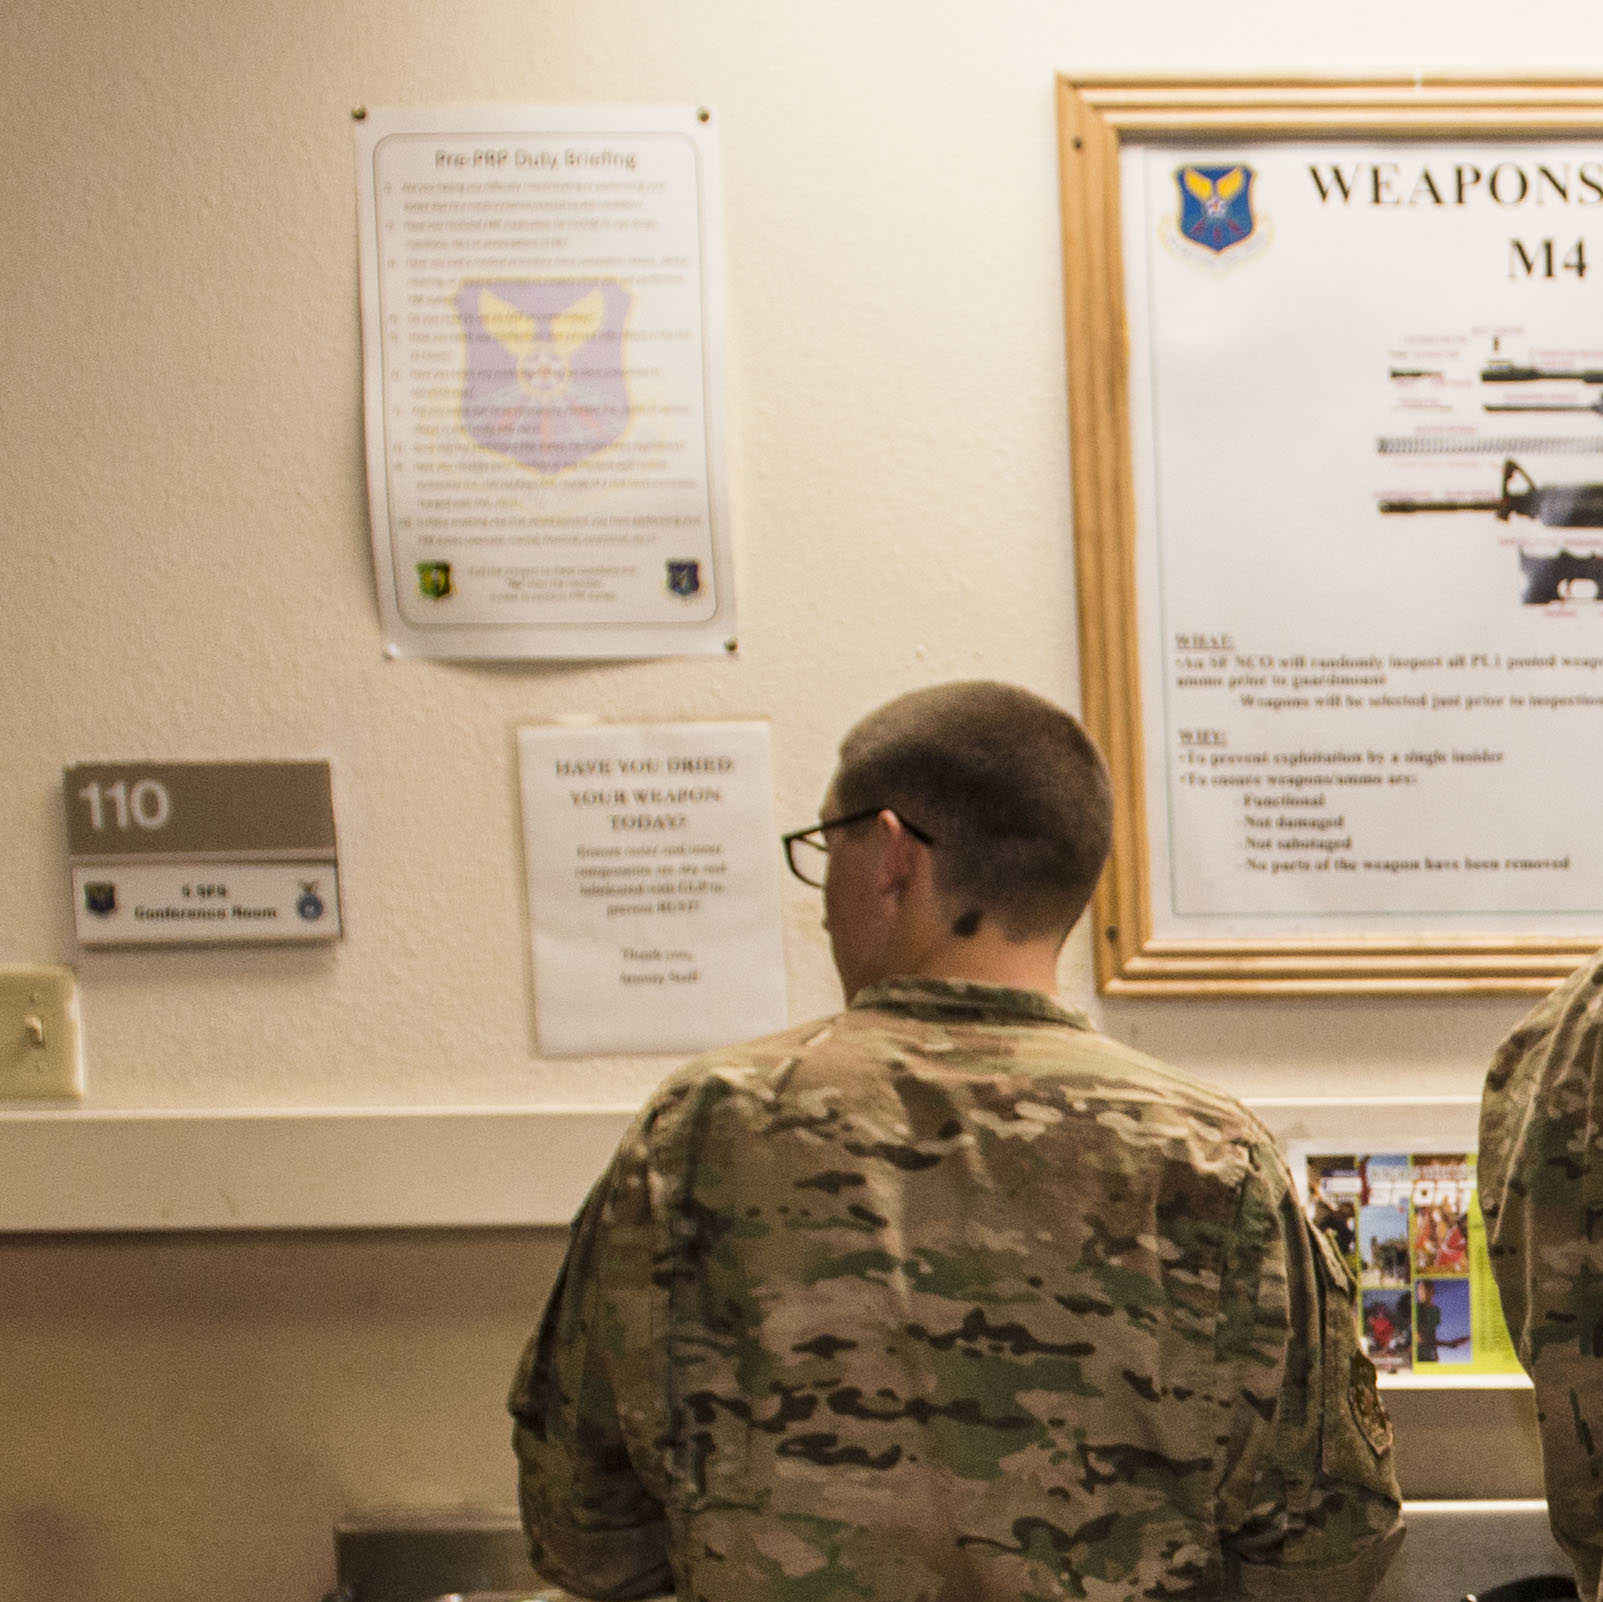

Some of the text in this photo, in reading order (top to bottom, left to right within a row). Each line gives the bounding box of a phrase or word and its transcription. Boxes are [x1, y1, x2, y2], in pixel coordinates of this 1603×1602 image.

[514, 149, 558, 170] Duty
[564, 149, 638, 170] Briefing
[1509, 237, 1589, 280] M4
[555, 755, 734, 778] HAVE YOU DRIED
[78, 777, 170, 832] 110
[570, 785, 722, 808] YOUR WEAPON
[134, 904, 278, 923] Conference Room
